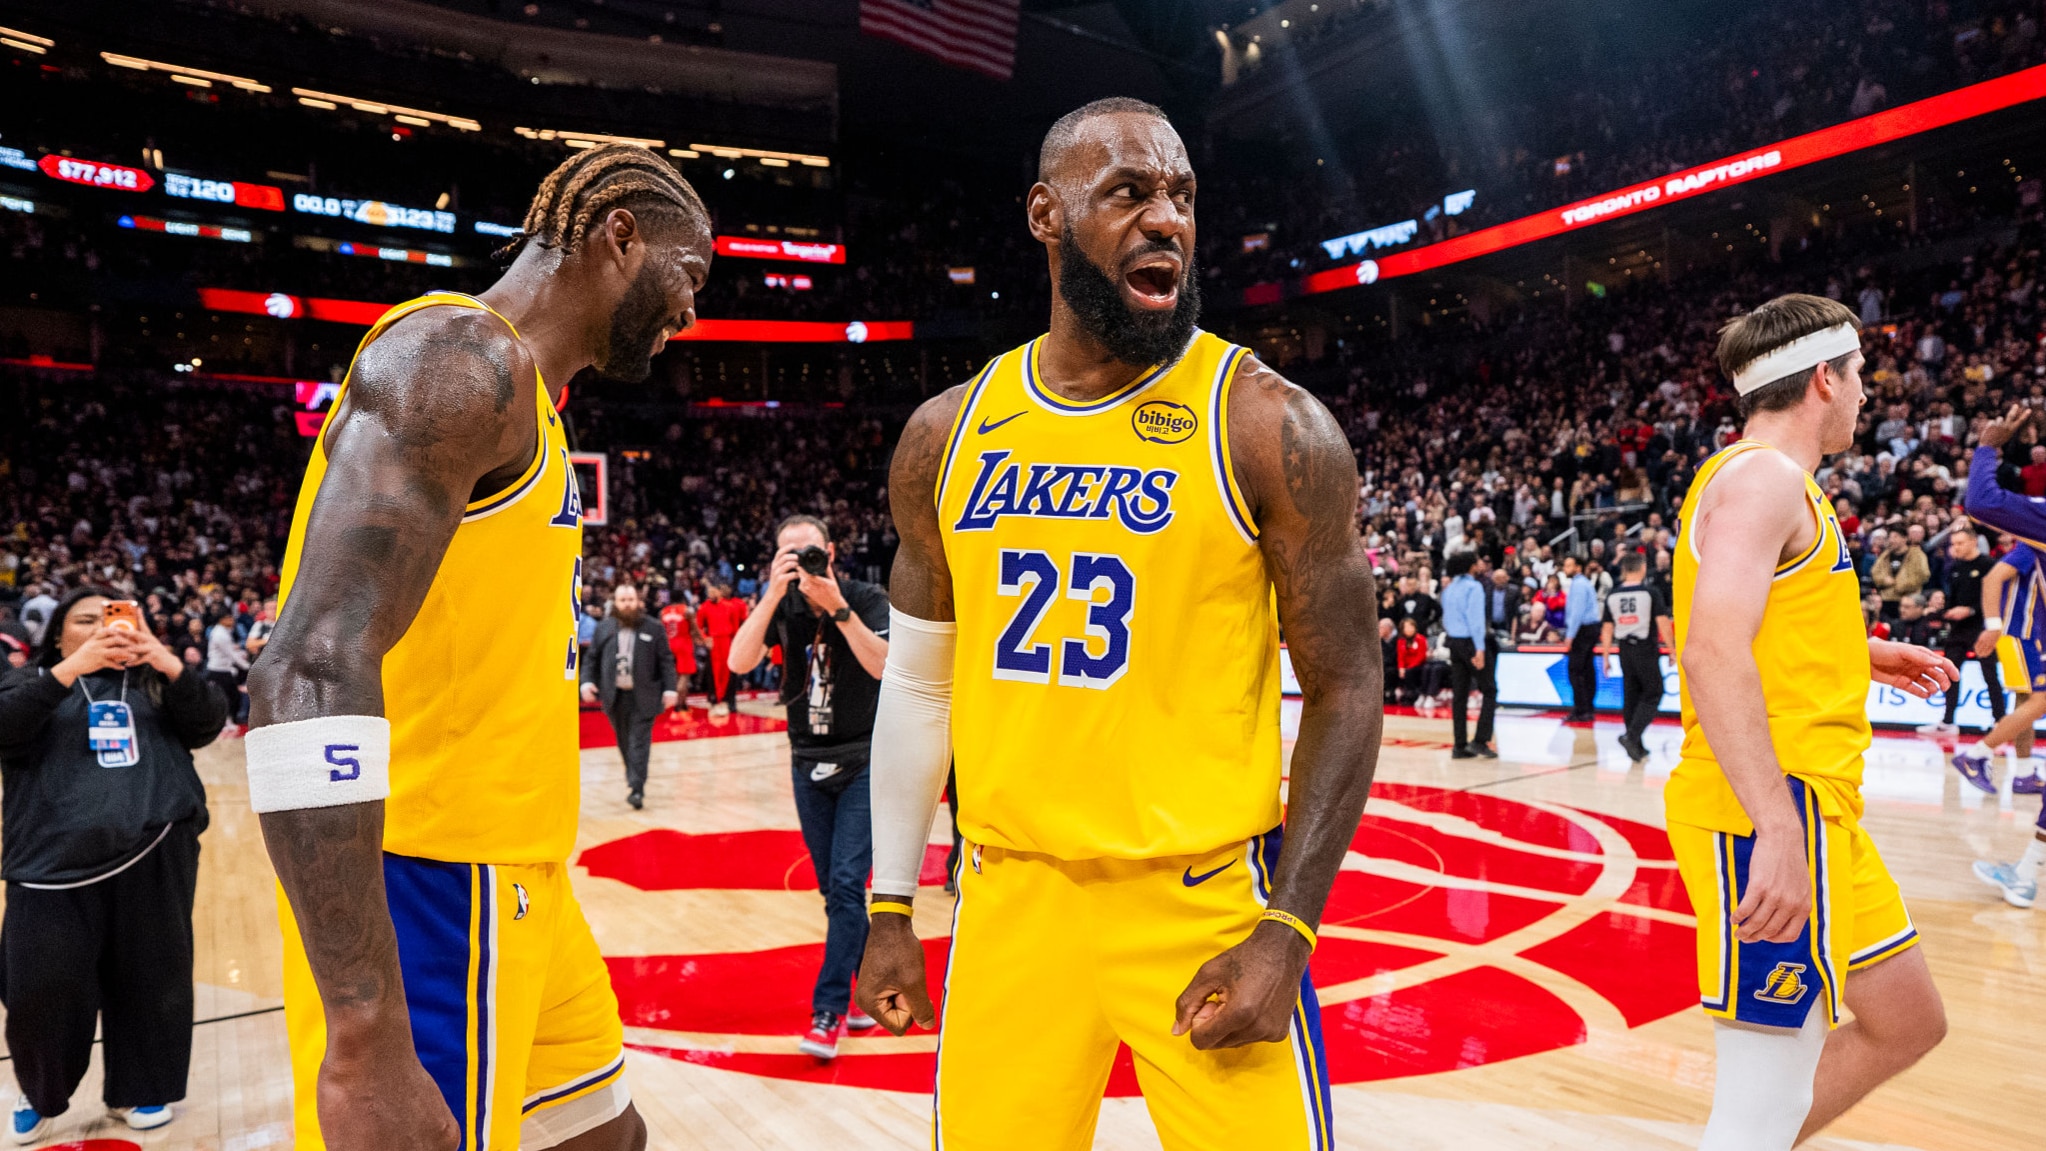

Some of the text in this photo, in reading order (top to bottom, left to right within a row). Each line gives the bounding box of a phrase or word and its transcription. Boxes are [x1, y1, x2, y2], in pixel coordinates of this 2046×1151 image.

[58, 159, 137, 188] $77,912
[1561, 150, 1781, 225] TORONTO RAPTORS
[190, 178, 235, 203] 120
[1138, 409, 1194, 433] bibigo
[1146, 425, 1169, 435] 비비고
[953, 449, 1179, 535] LAKERS
[992, 547, 1137, 690] 23
[1620, 597, 1636, 614] 26
[324, 744, 360, 782] 5
